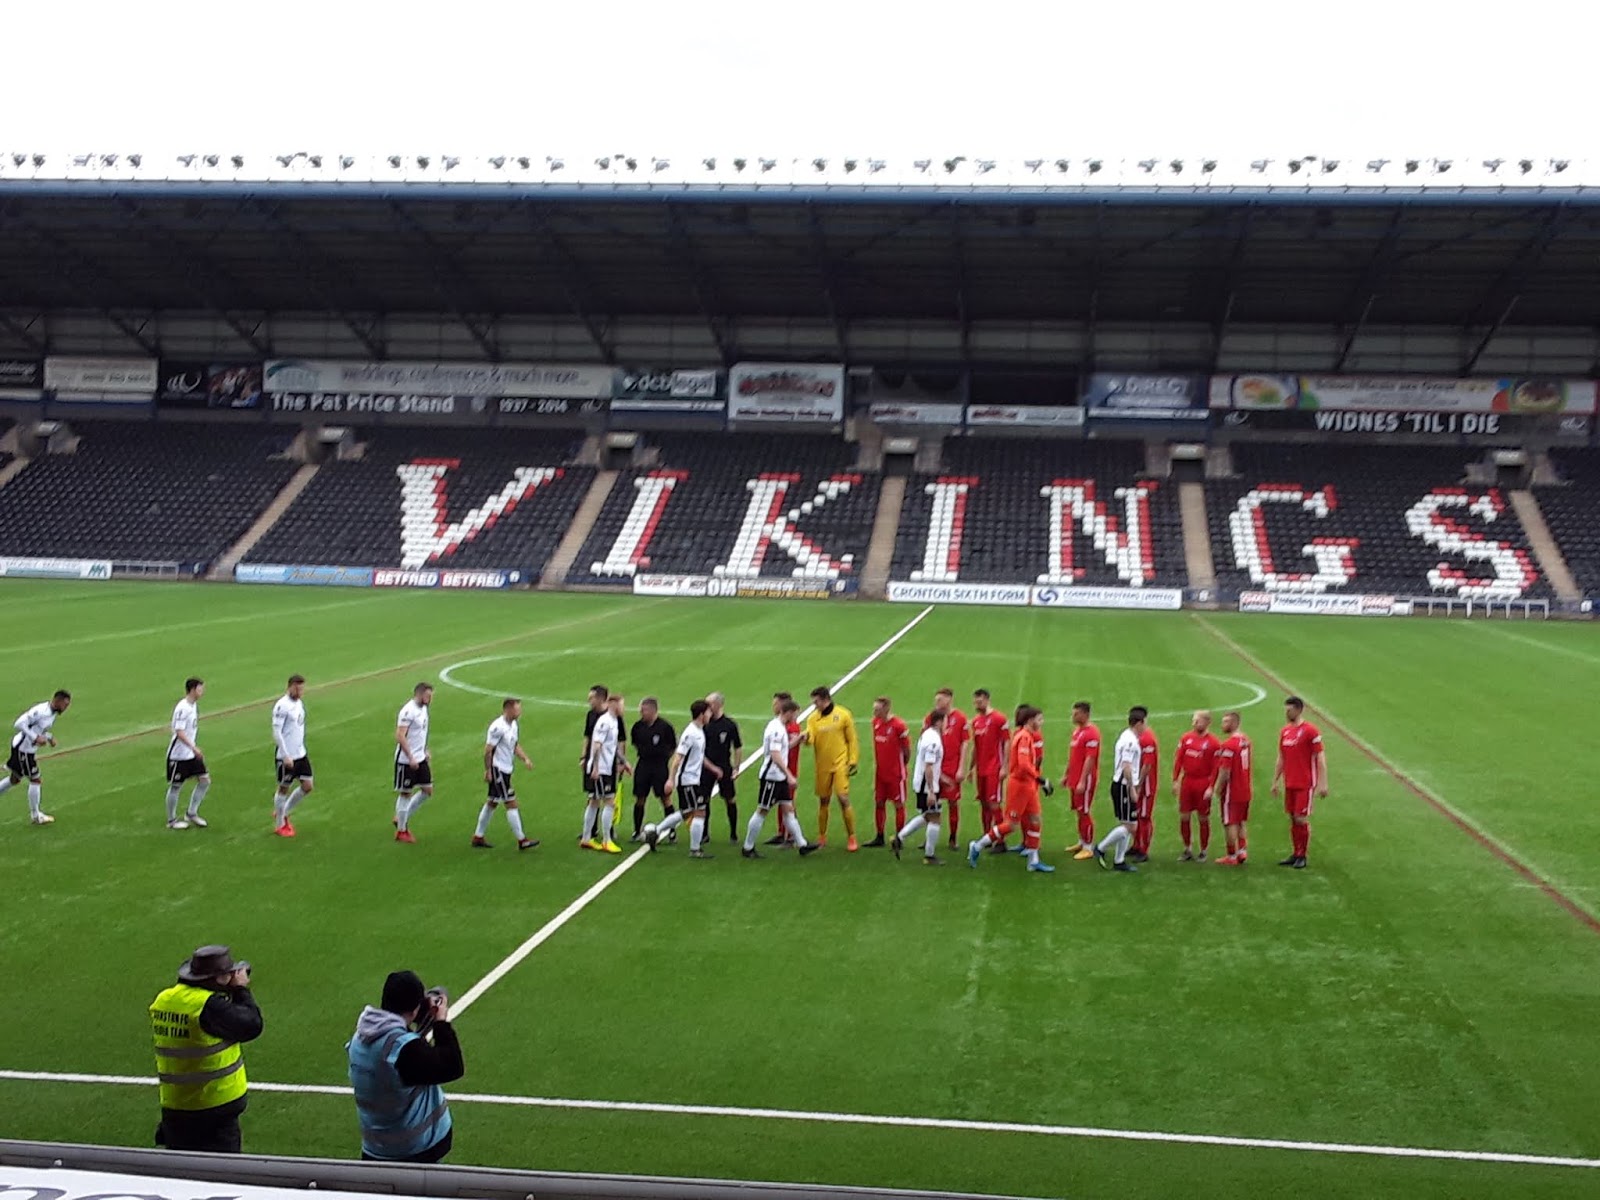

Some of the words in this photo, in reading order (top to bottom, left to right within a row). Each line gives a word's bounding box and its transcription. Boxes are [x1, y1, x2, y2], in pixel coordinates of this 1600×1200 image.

[270, 392, 306, 411] The
[310, 393, 342, 412] Pat
[346, 393, 396, 412] Price
[399, 394, 454, 413] Stand
[1314, 411, 1399, 432] WIDNES
[1448, 413, 1457, 433] I
[1461, 412, 1500, 434] DIE
[397, 459, 1538, 598] VIKINGS
[374, 570, 438, 586] BETFRED
[441, 572, 506, 588] BETFRED
[892, 586, 951, 599] CRONTON
[953, 587, 988, 600] SIXTH
[990, 588, 1025, 600] FORM
